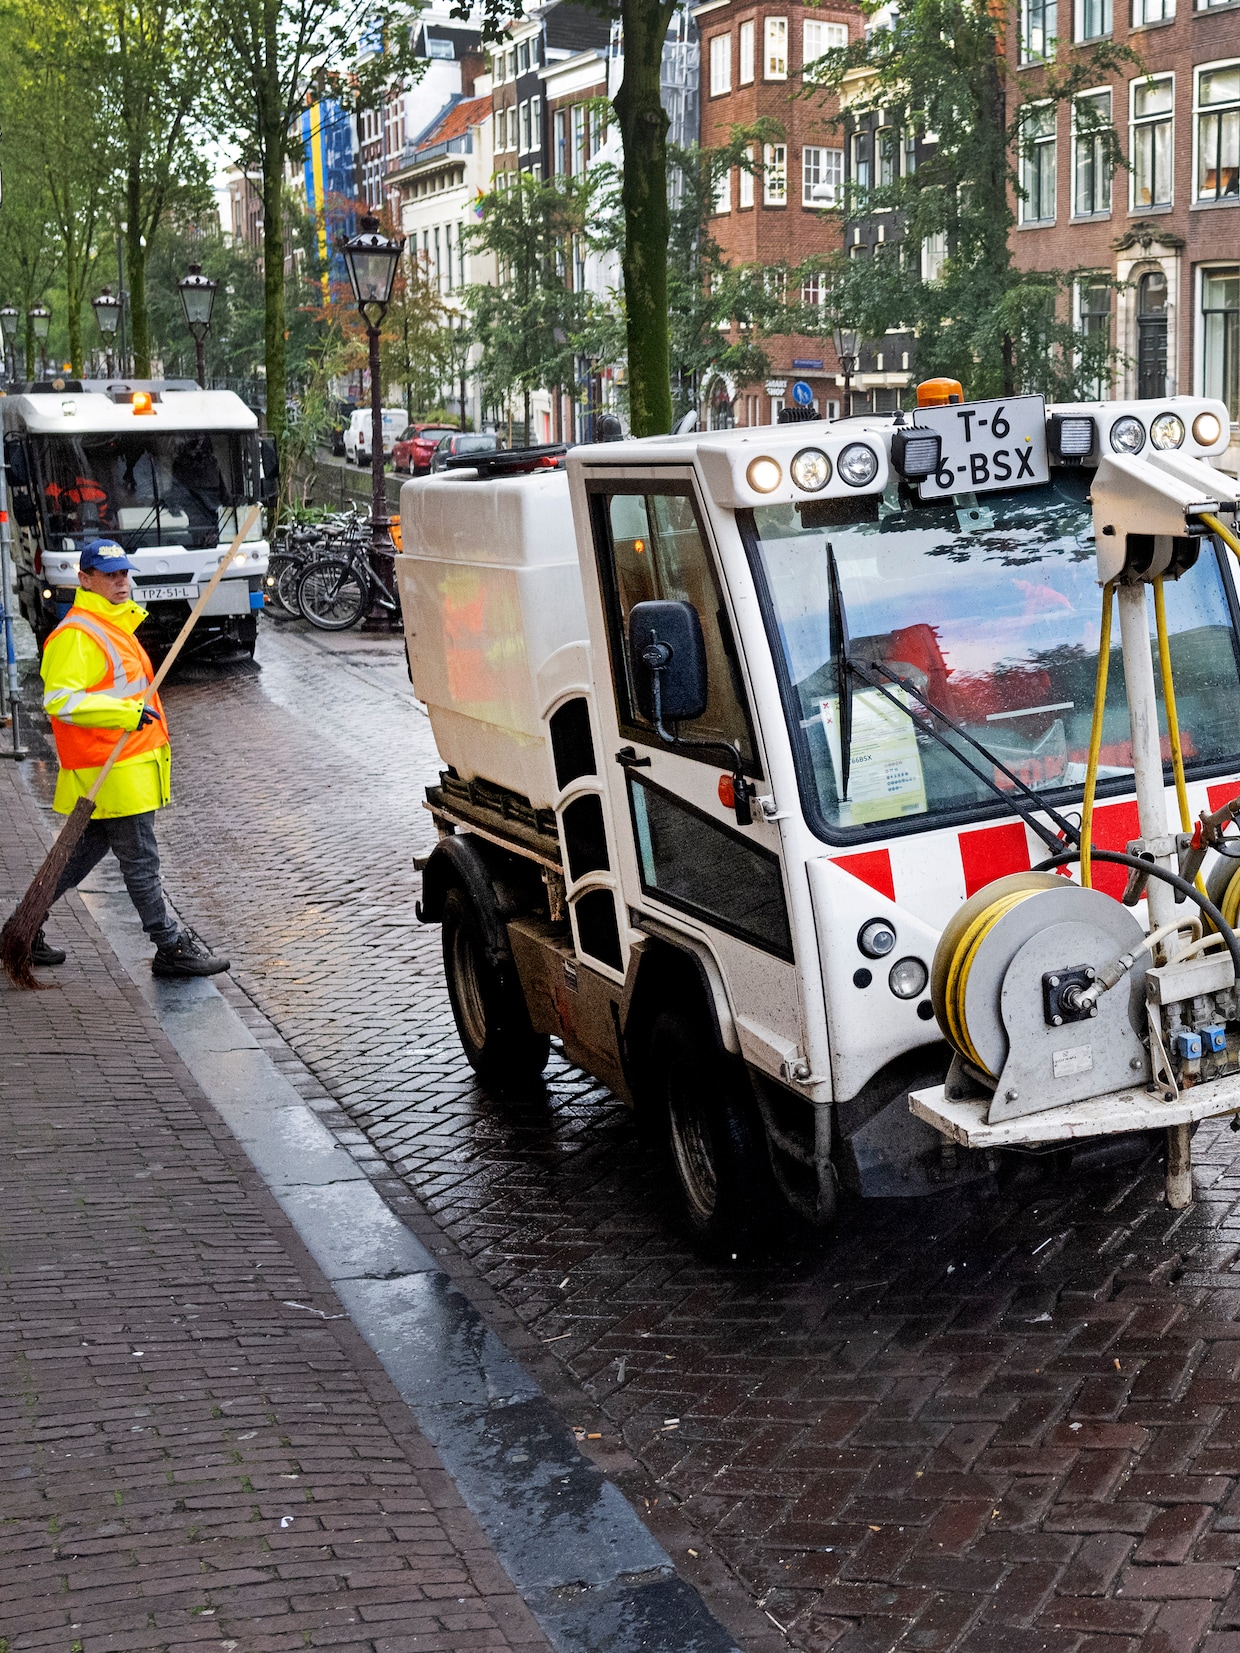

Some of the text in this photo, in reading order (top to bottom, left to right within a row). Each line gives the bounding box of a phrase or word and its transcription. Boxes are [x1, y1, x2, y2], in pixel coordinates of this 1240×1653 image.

[766, 388, 785, 396] SHOP
[957, 406, 1010, 442] T-6
[935, 446, 1035, 489] 6-BSX
[141, 588, 189, 599] TPZ-51-L
[849, 755, 873, 764] 66BSX
